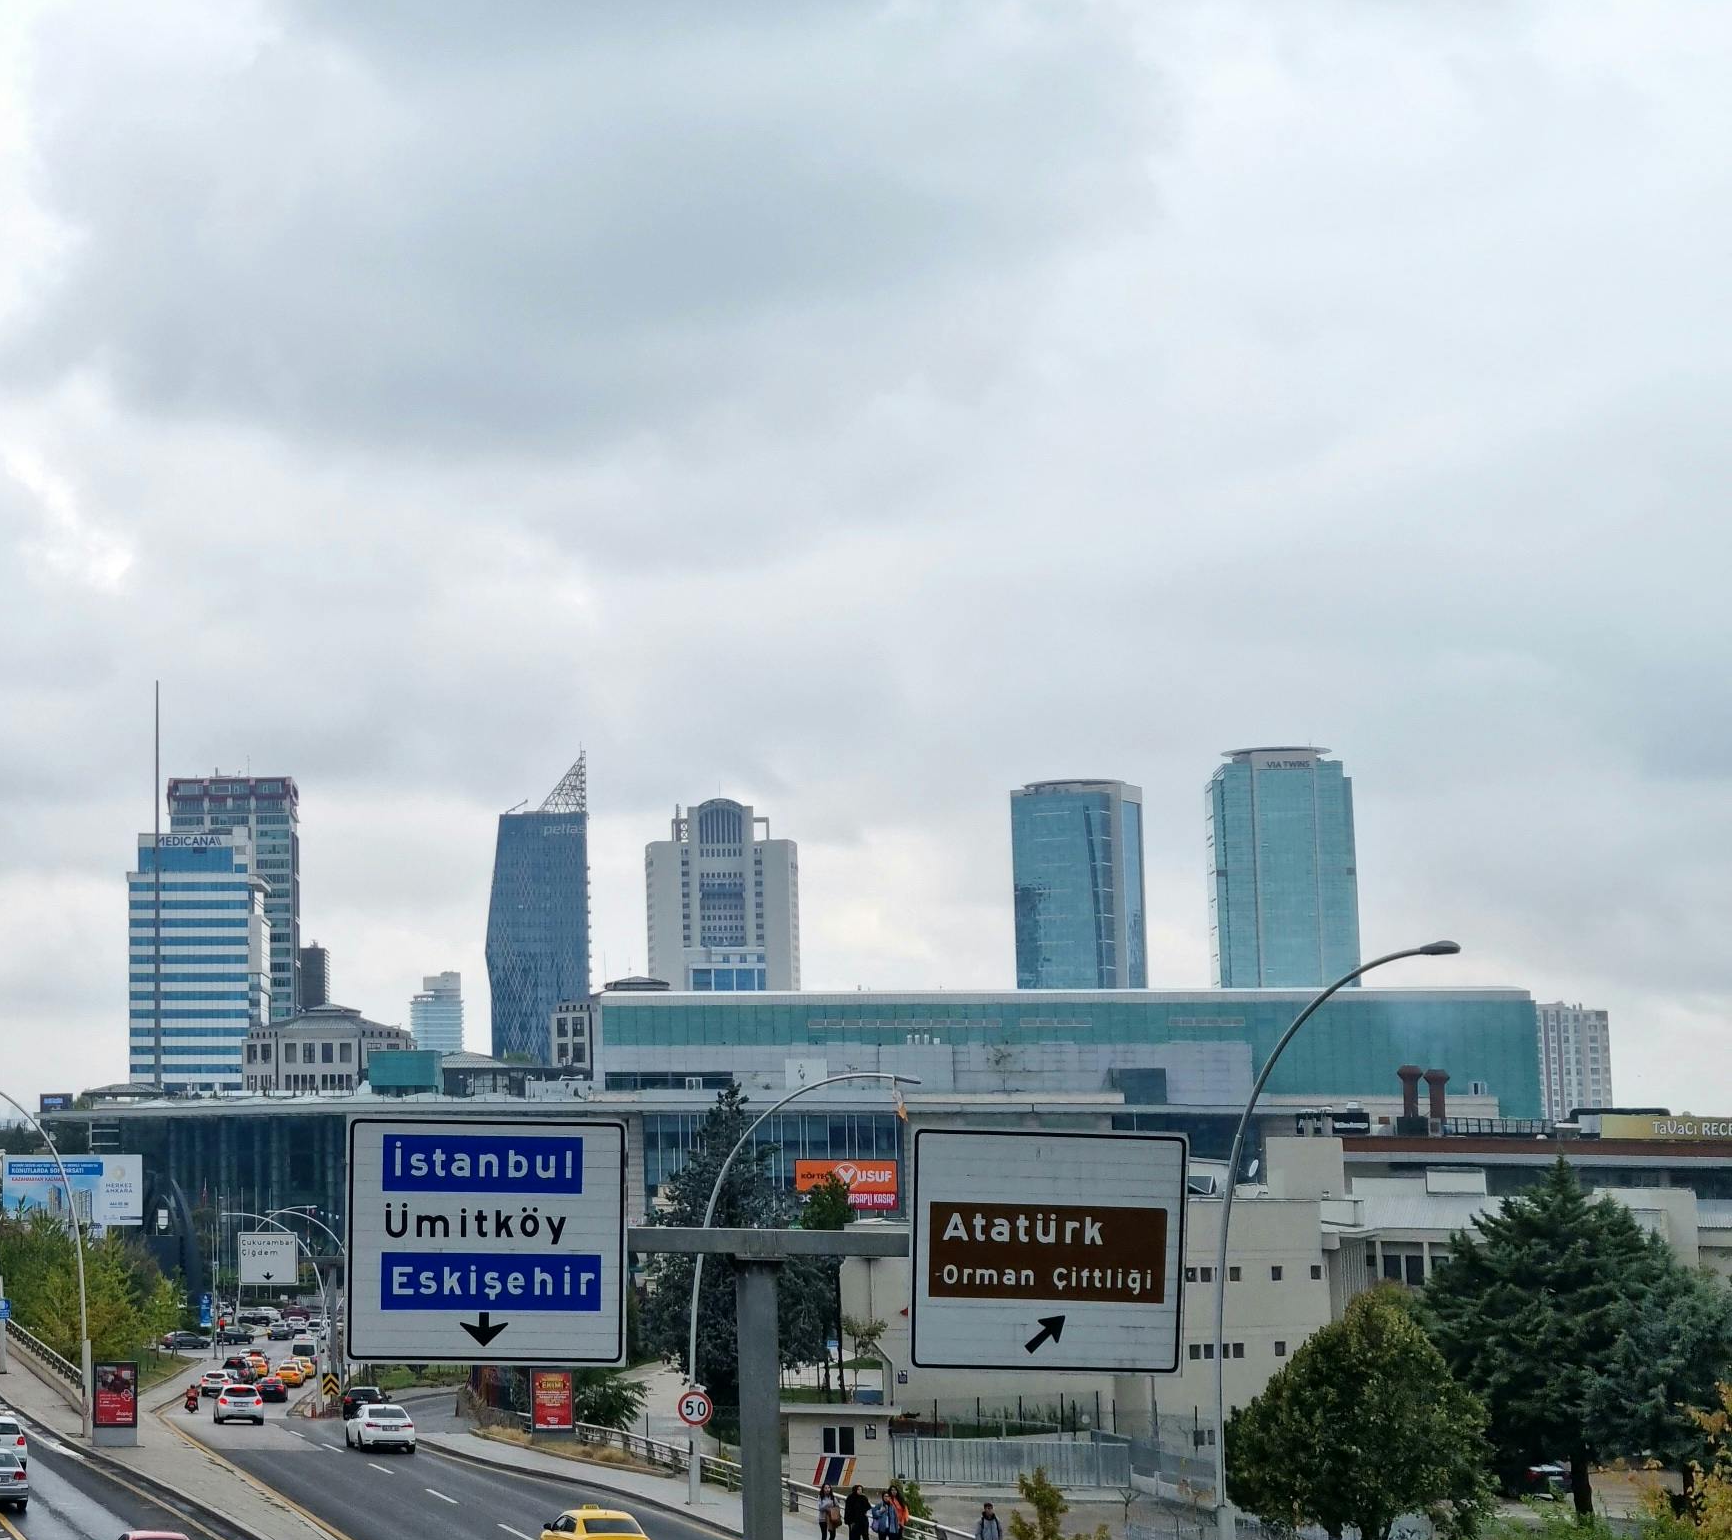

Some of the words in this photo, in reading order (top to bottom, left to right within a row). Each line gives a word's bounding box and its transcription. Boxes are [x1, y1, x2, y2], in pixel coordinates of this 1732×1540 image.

[394, 1141, 573, 1179] İstanbul
[385, 1202, 567, 1245] Ümitköy
[942, 1212, 1104, 1245] Atatürk
[392, 1265, 596, 1300] Eskişehir
[943, 1264, 1035, 1286] Orman
[1053, 1266, 1152, 1295] Çiftliği
[685, 1400, 706, 1416] 50
